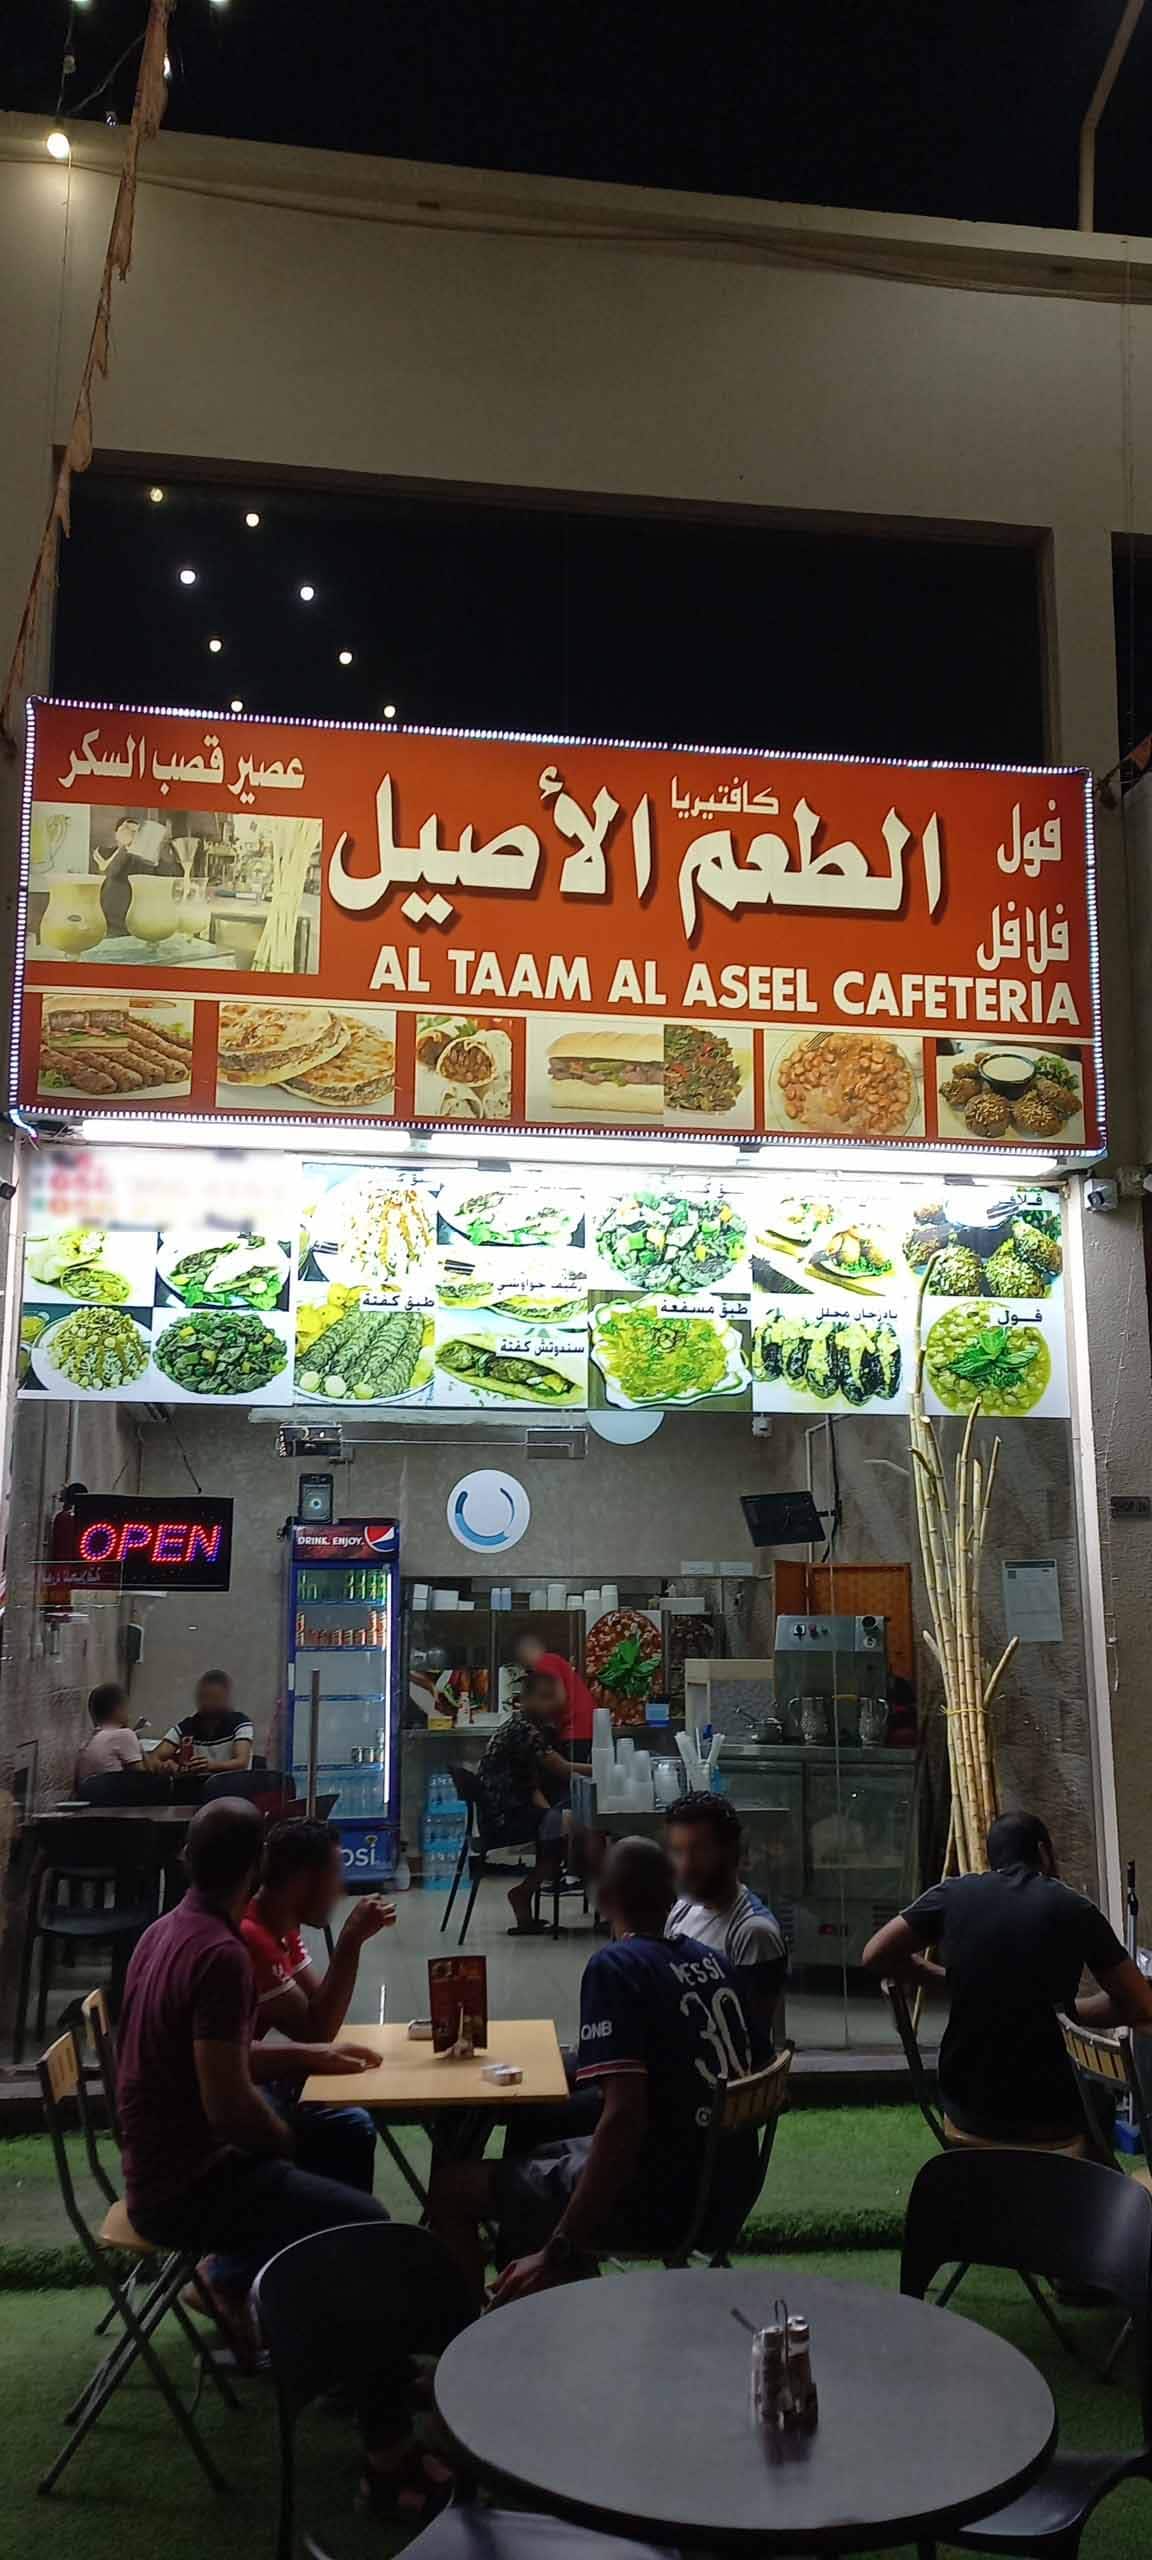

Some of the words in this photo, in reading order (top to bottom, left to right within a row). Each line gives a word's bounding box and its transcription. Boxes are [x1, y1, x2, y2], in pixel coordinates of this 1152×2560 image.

[57, 728, 146, 788] السكر
[152, 735, 225, 795] قصب
[227, 754, 305, 804] عصير
[671, 776, 779, 820] كافتيريا
[328, 766, 651, 925] الأصيل
[997, 800, 1062, 878] فول
[678, 797, 941, 940] الطعم
[976, 900, 1069, 974] فلافل
[369, 945, 431, 993] AL
[447, 949, 592, 1002] TAAM
[607, 958, 667, 1006] AL
[682, 962, 818, 1013] ASEEL
[832, 970, 1081, 1026] CAFETERIA
[362, 1292, 401, 1307] كفتة
[405, 1295, 435, 1311] طبق
[718, 1302, 749, 1319] طبق
[997, 1308, 1043, 1325] فول
[79, 1522, 222, 1562] OPEN
[580, 2020, 613, 2041] QNB
[679, 1987, 753, 2088] 30
